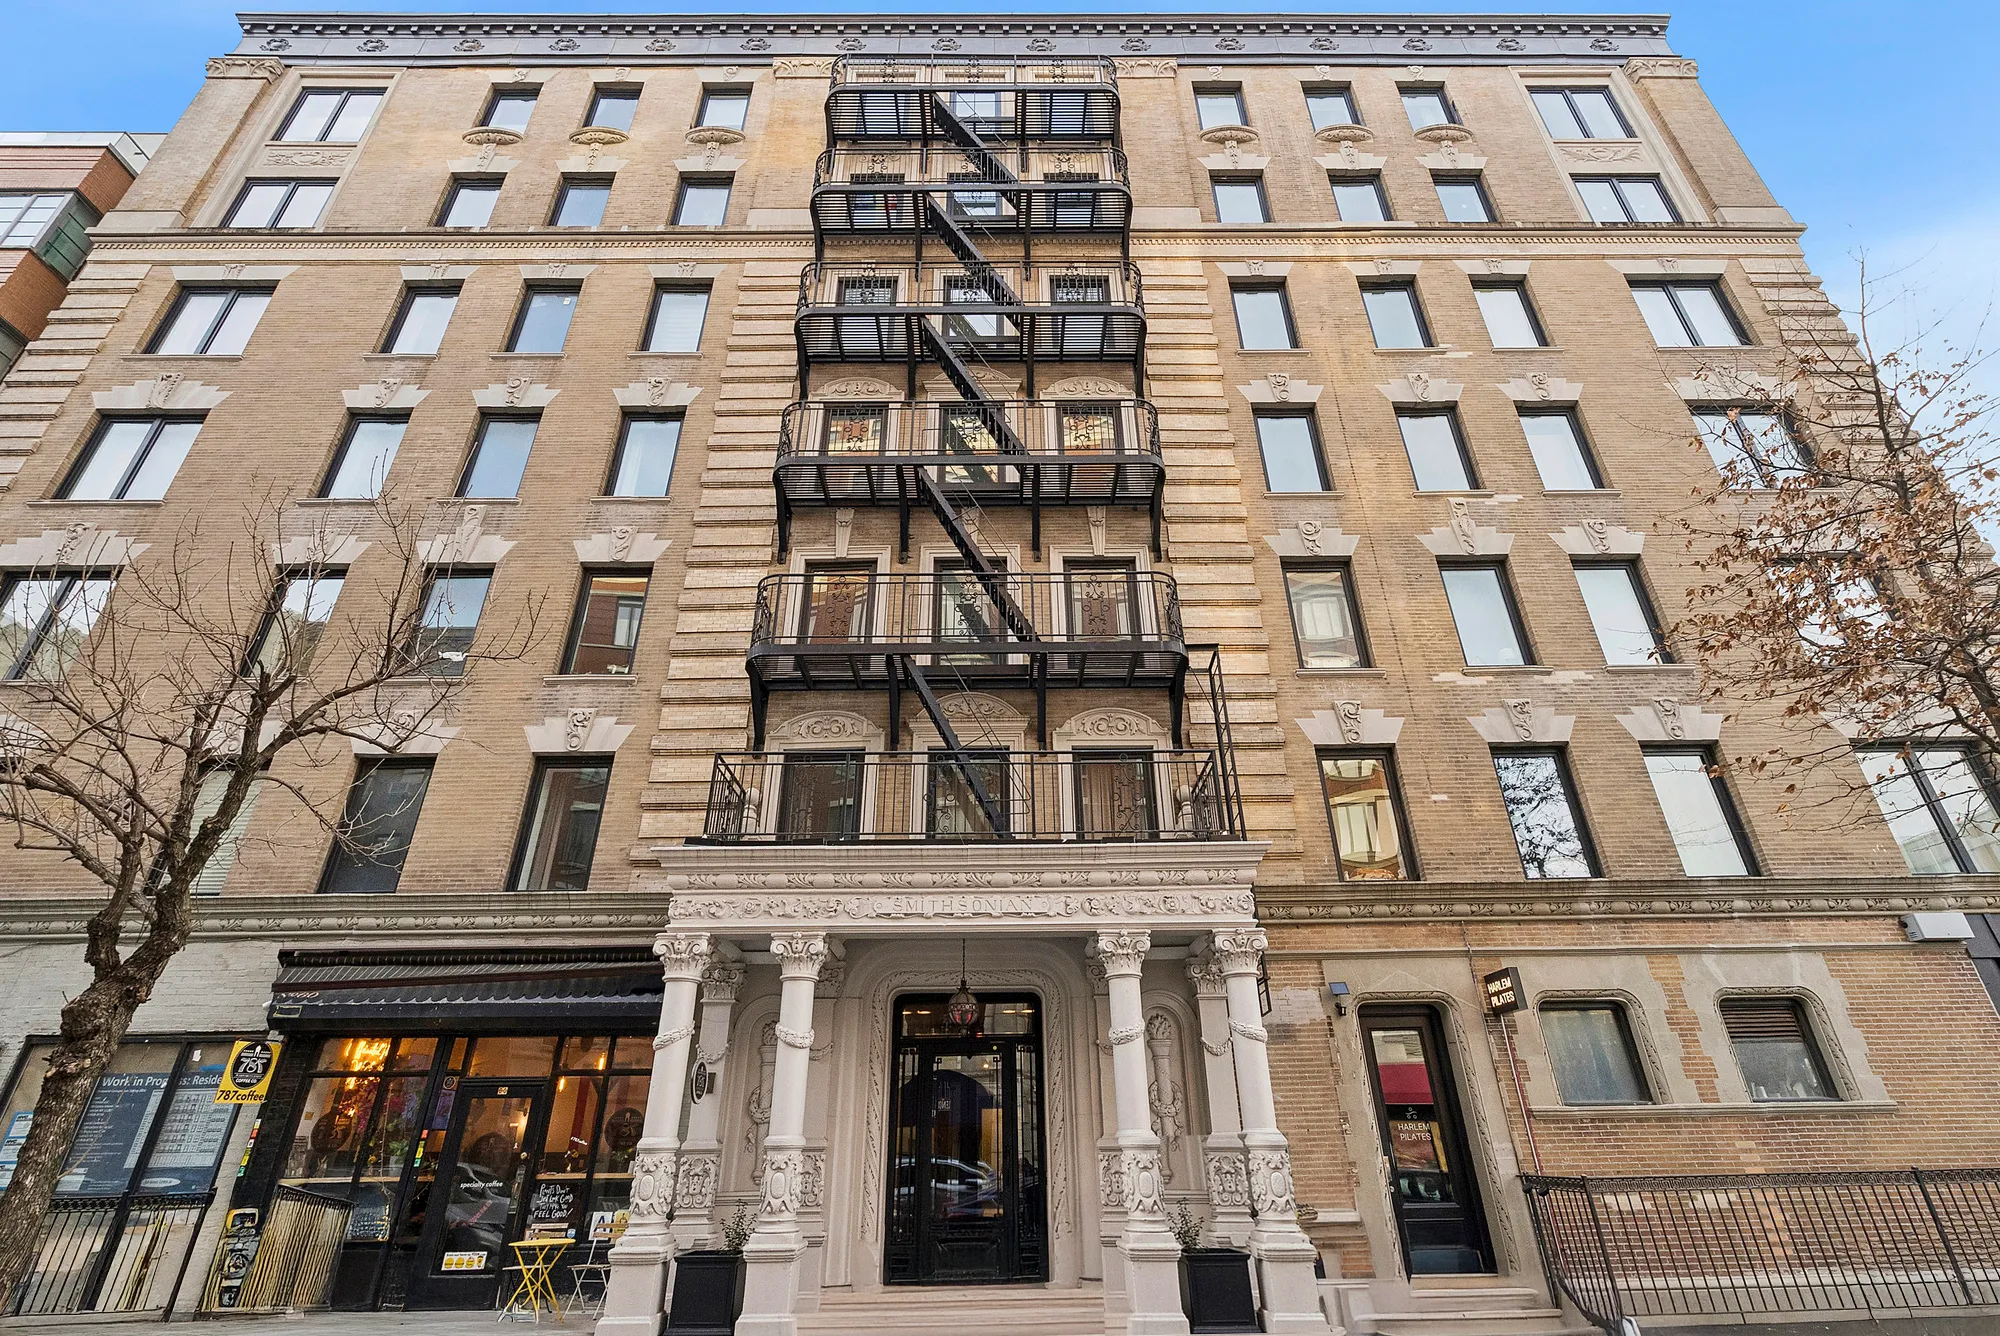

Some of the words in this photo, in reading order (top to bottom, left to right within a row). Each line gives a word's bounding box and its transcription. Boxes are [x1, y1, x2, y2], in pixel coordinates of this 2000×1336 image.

[892, 900, 1033, 912] SMITHSONIAN
[1487, 977, 1512, 994] HARLEM
[1491, 991, 1515, 1008] PILATES
[102, 1076, 130, 1087] Work
[133, 1076, 143, 1086] in
[145, 1076, 191, 1088] Progss:
[192, 1074, 222, 1086] Reside
[216, 1089, 265, 1101] 787coffee
[1397, 1122, 1431, 1131] HARLEM
[1400, 1132, 1432, 1141] PILATES
[460, 1181, 486, 1190] specialty
[486, 1180, 504, 1188] coffee
[560, 1193, 574, 1204] GOOD
[533, 1210, 550, 1219] FEEL
[551, 1207, 574, 1219] GOOD!
